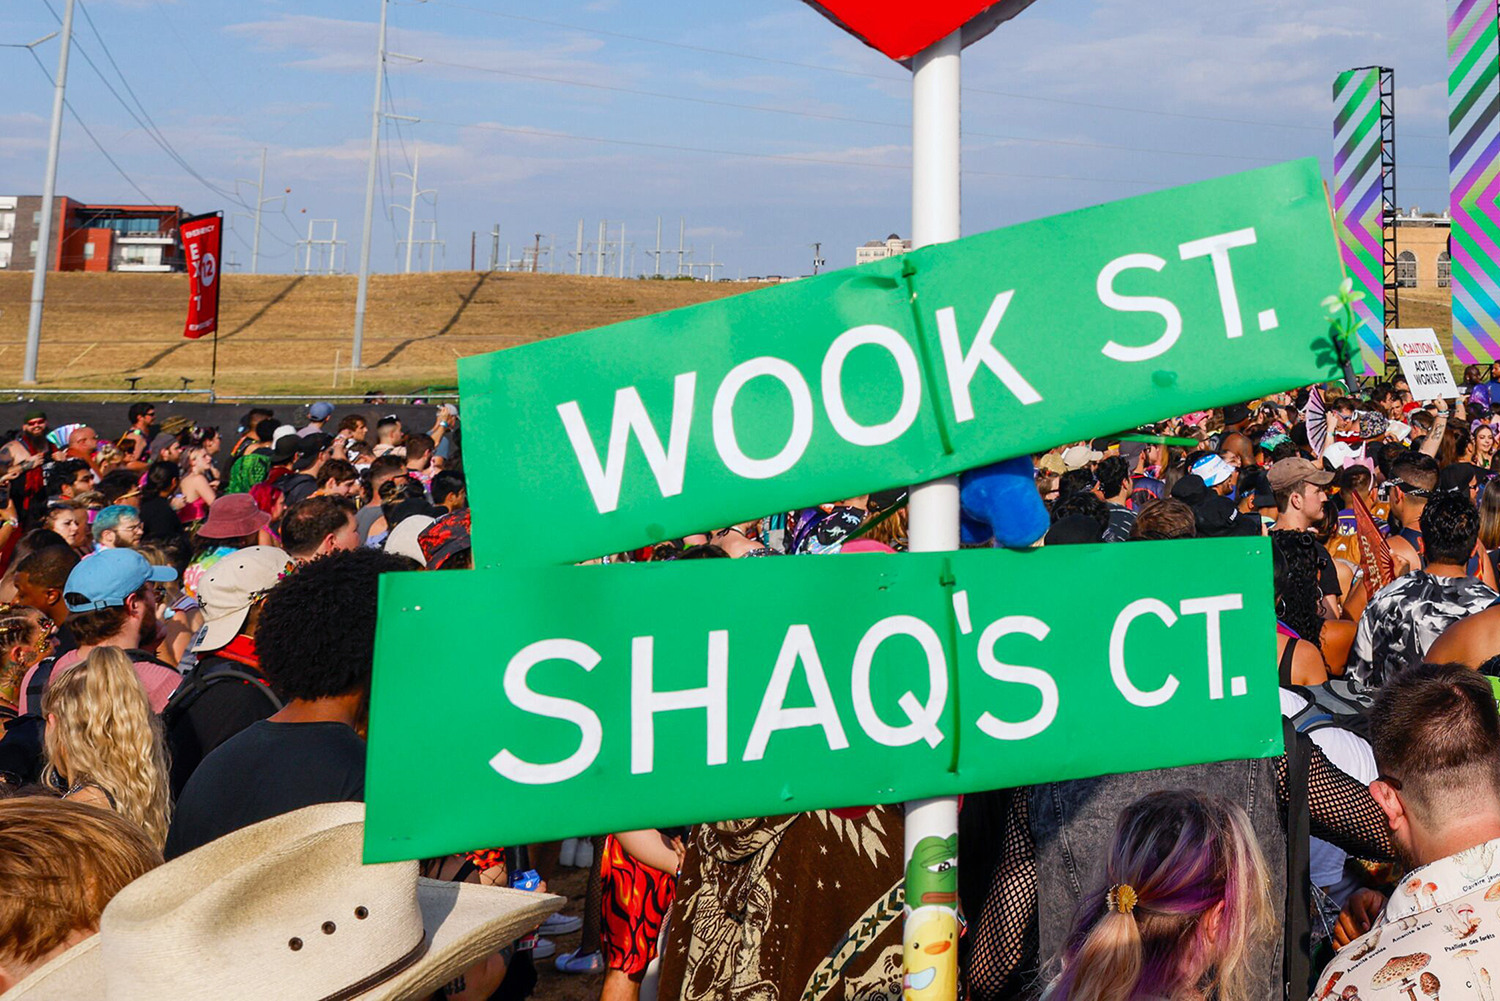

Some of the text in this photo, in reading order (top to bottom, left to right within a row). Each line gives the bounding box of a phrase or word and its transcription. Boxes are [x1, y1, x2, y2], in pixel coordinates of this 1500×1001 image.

[201, 259, 213, 279] 12
[1403, 342, 1434, 354] CAUTION
[557, 227, 1279, 514] WOOK ST.
[1414, 360, 1438, 372] ACTIVE
[1414, 372, 1448, 386] WORKSITE
[489, 590, 1248, 785] SHAQ'S CT.
